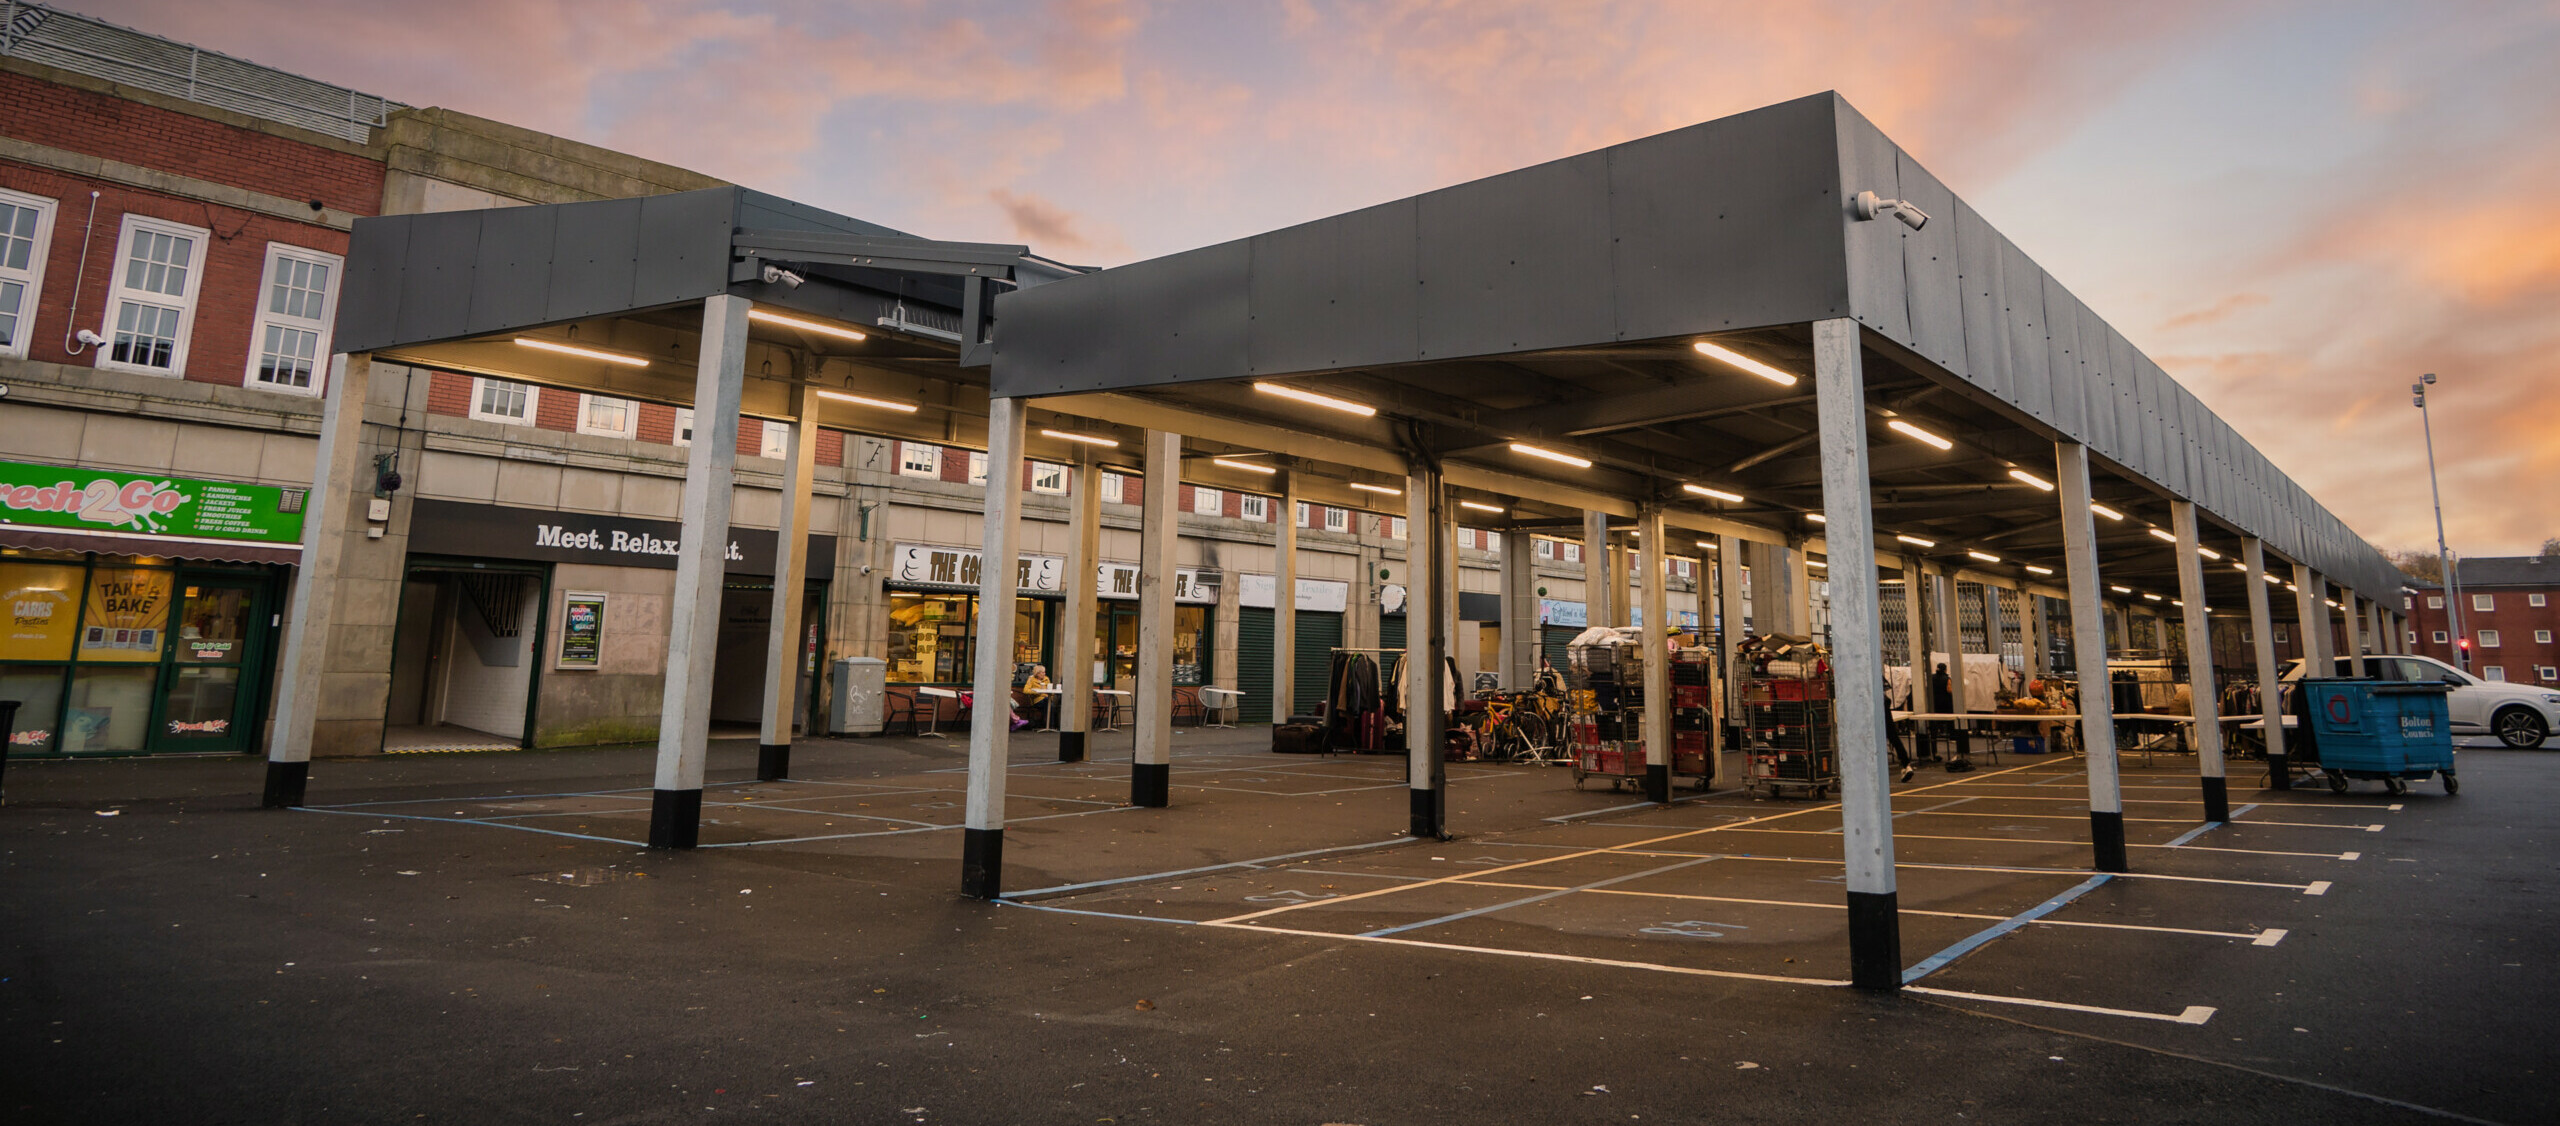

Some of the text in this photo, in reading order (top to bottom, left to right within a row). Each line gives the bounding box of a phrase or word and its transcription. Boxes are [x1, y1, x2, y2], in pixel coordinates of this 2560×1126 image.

[206, 493, 251, 501] SANDWICHES
[536, 524, 604, 550] Meet.
[610, 530, 680, 556] Relax.
[930, 551, 958, 583] THE
[1113, 568, 1134, 593] THE
[101, 582, 146, 597] TAKE
[14, 600, 54, 617] CARRS
[106, 598, 153, 614] BAKE
[571, 614, 594, 622] YOUTH
[2401, 716, 2431, 727] Bolton
